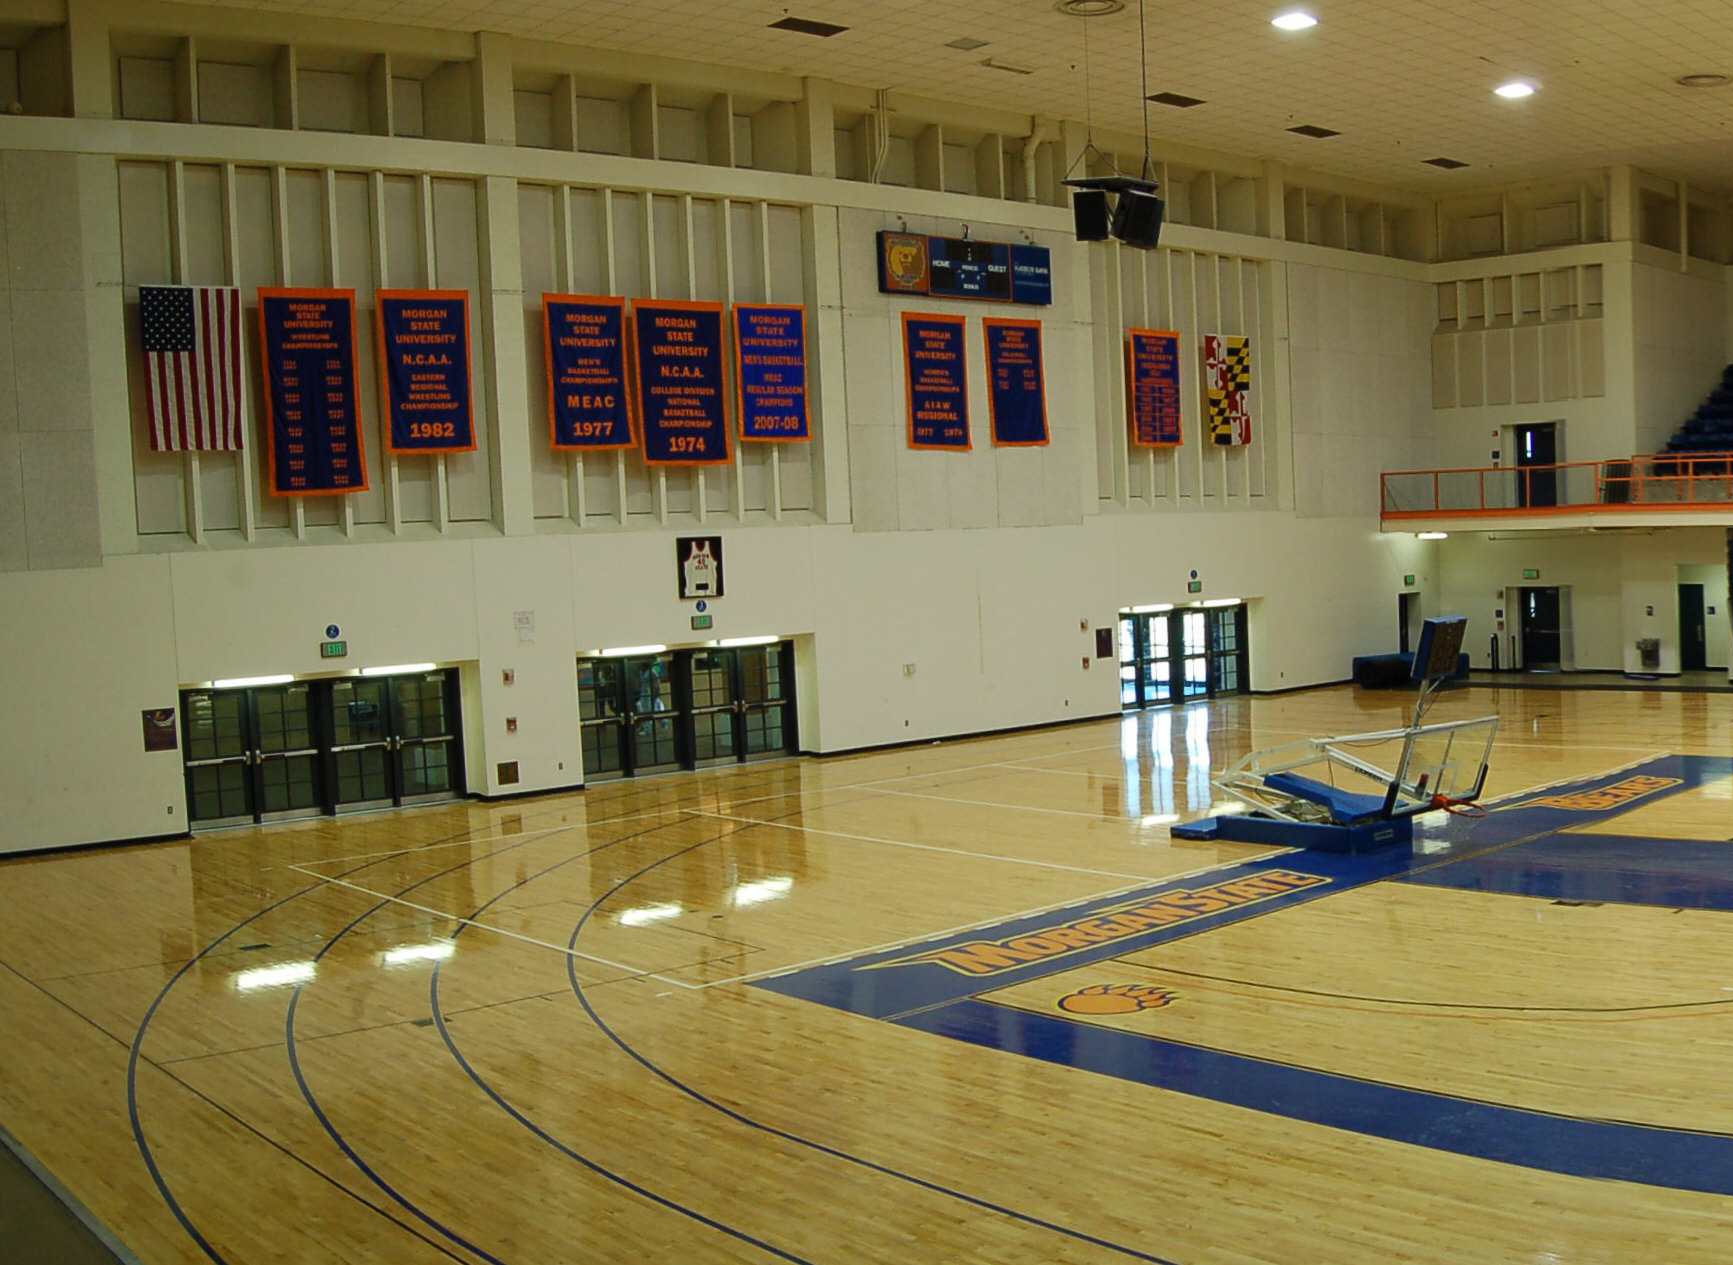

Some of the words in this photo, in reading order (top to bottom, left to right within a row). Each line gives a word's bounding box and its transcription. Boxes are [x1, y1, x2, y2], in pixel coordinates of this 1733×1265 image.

[932, 259, 950, 268] HOME
[988, 265, 1006, 273] GUEST
[402, 309, 447, 318] MORGAN
[566, 313, 607, 323] MORGAN
[656, 317, 697, 328] MORGAN
[750, 315, 791, 325] MORGAN
[411, 321, 441, 330] STATE
[574, 326, 600, 335] STATE
[756, 326, 785, 335] STATE
[396, 334, 457, 344] UNIVERSITY
[667, 331, 694, 341] STATE
[560, 338, 616, 347] UNIVERSITY
[743, 338, 798, 347] UNIVERSITY
[653, 346, 708, 356] UNIVERSITY
[403, 354, 452, 365] N.C.A.A.
[661, 366, 705, 378] N.C.A.A.
[567, 395, 616, 409] MEAC
[754, 416, 799, 430] 2007-08
[410, 422, 455, 437] 1982
[573, 422, 613, 436] 1977
[669, 436, 706, 452] 1974
[939, 903, 1199, 973] MORGAN
